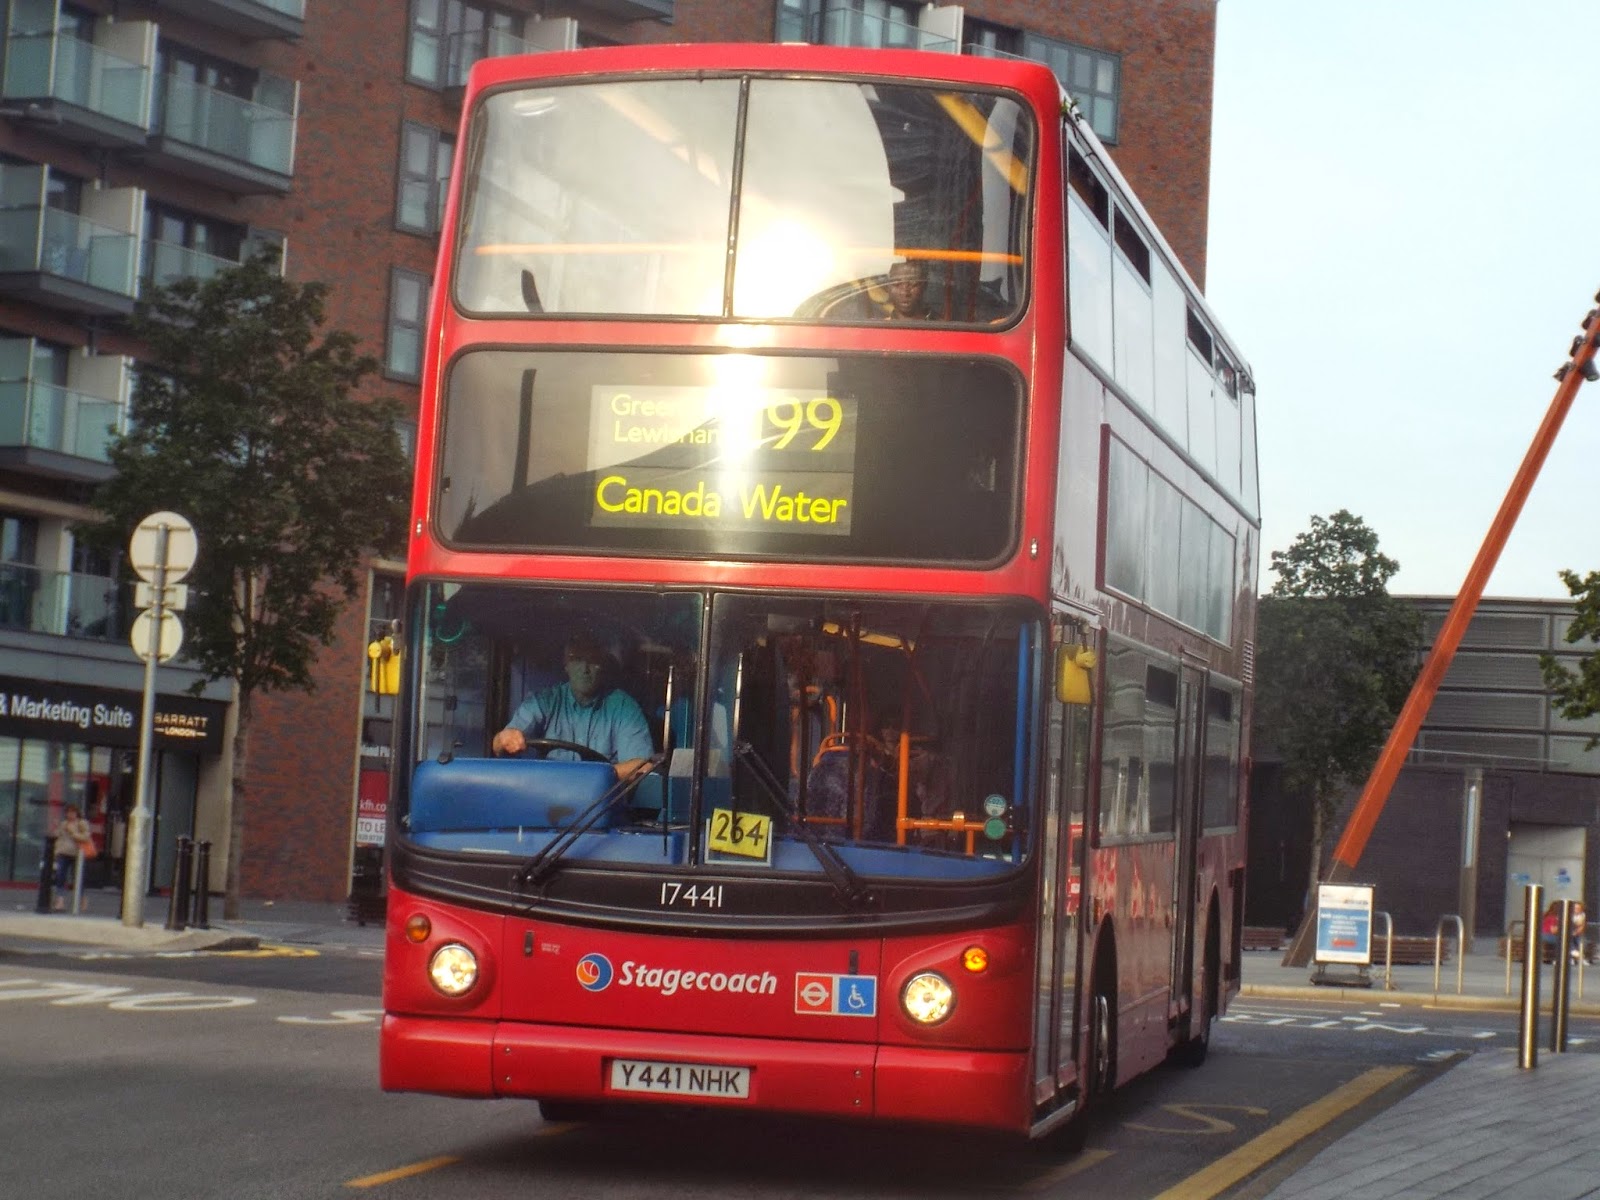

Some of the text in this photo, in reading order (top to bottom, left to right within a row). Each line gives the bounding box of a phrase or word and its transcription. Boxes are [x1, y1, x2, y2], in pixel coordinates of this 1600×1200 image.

[752, 397, 843, 450] 99
[596, 475, 847, 523] Canada Water
[11, 694, 90, 728] Marketing
[93, 703, 133, 728] Suite
[154, 712, 209, 728] BARRATT
[374, 823, 385, 832] LE
[714, 812, 764, 846] 264
[660, 882, 723, 908] 17441
[618, 960, 778, 996] Stagecoach
